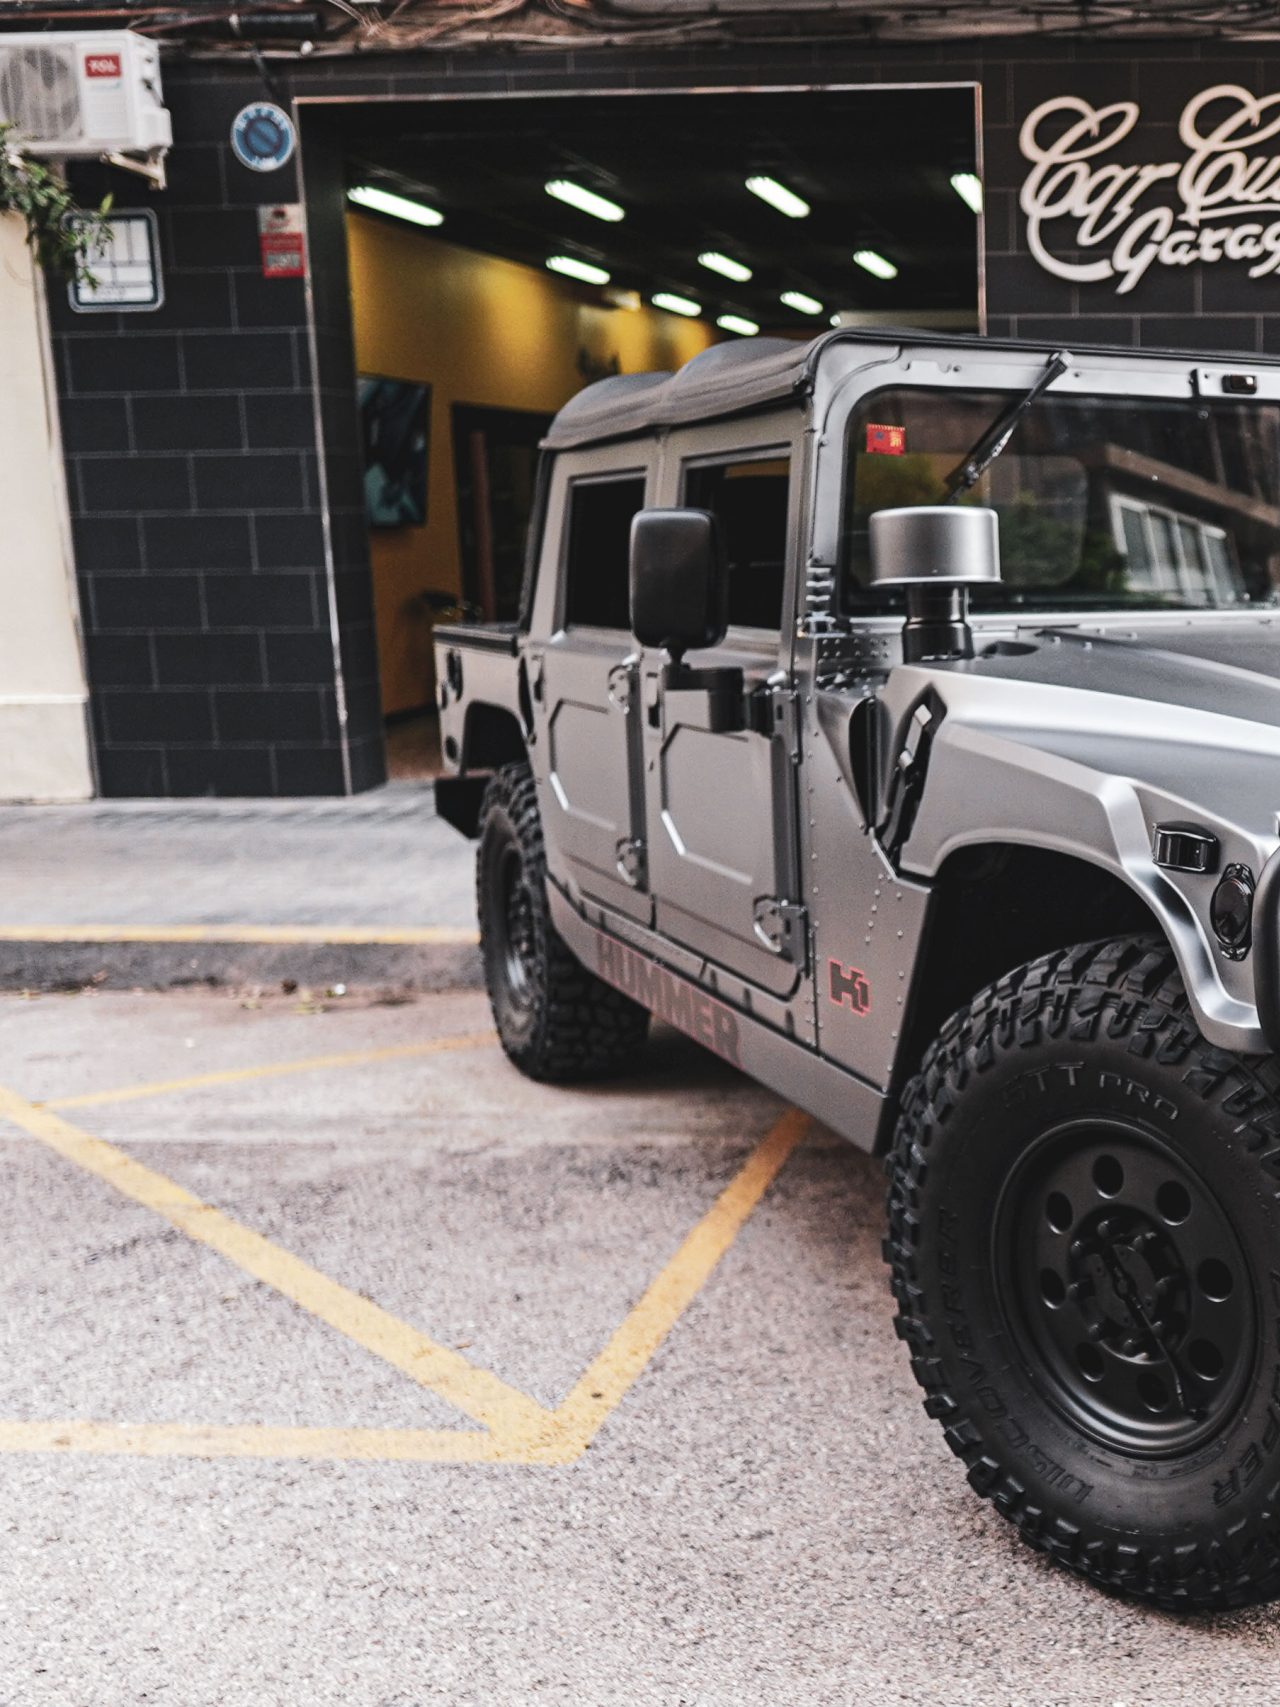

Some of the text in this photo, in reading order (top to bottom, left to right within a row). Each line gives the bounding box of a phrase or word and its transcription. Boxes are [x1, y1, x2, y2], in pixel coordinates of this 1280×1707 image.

[1020, 96, 1180, 275] Car
[597, 931, 744, 1069] HUMMER
[829, 956, 871, 1017] H1
